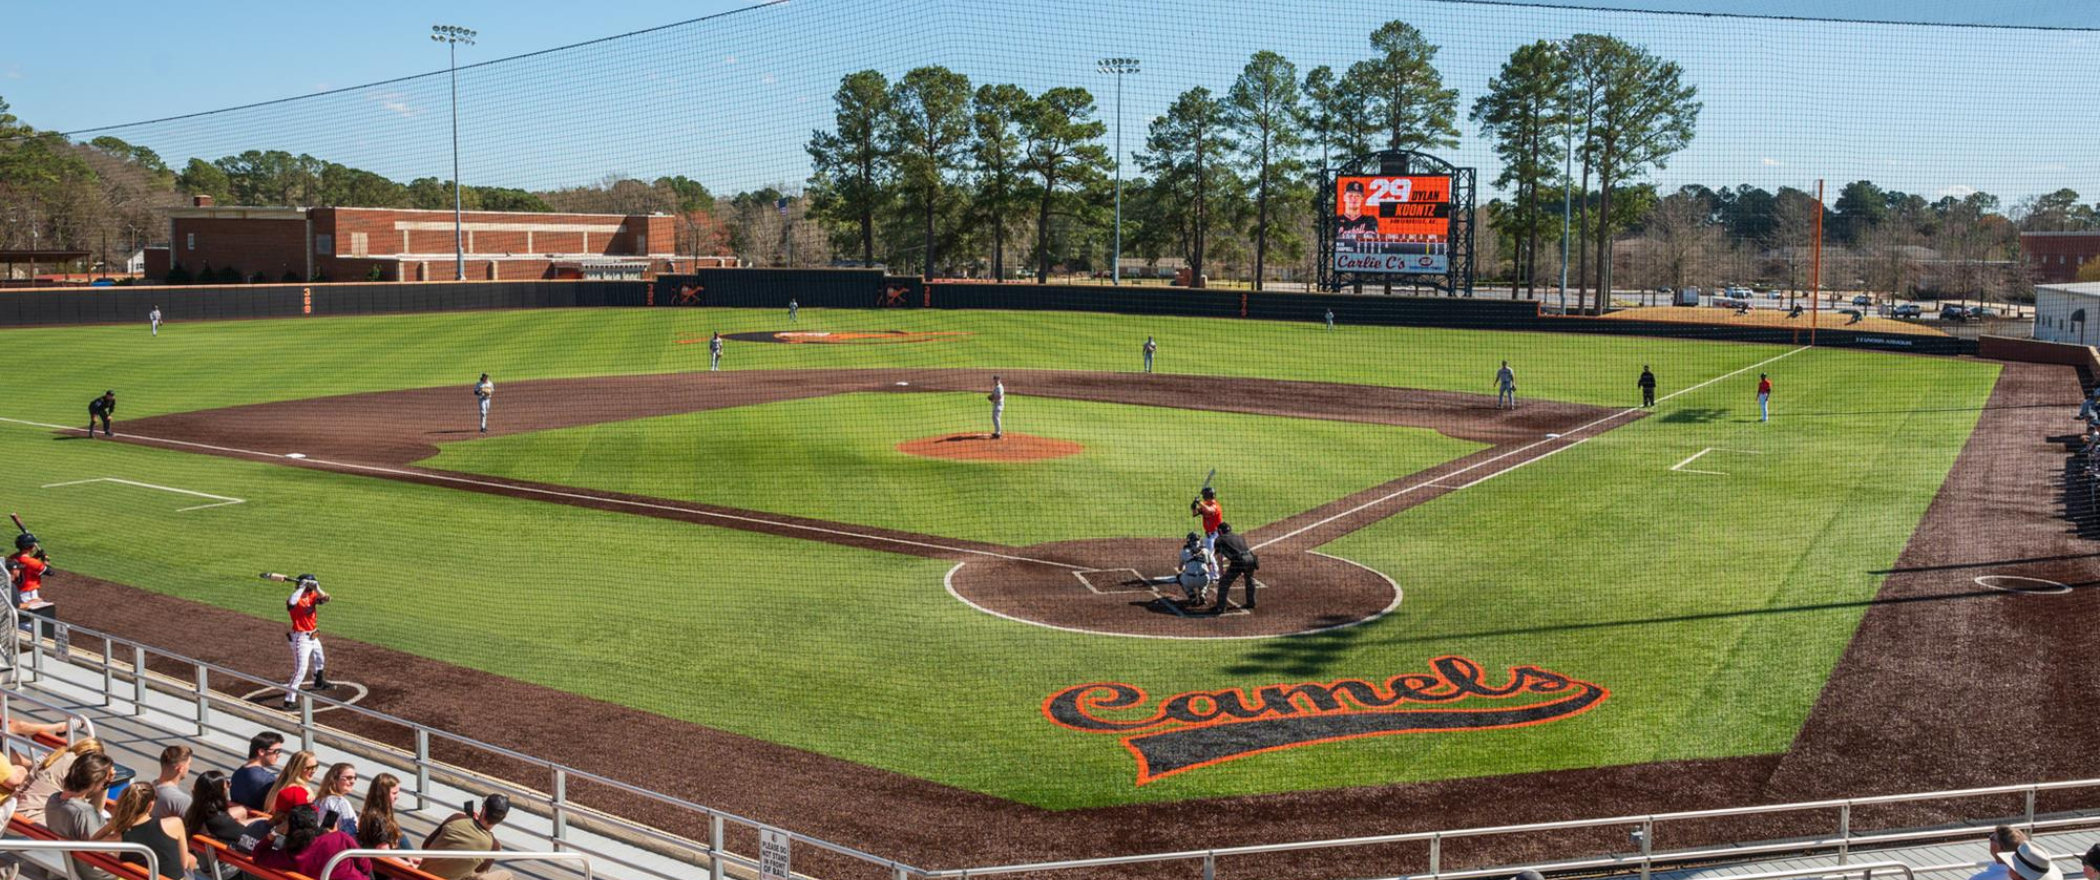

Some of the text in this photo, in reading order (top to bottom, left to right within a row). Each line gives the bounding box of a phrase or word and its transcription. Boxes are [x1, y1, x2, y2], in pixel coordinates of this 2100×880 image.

[1365, 178, 1412, 206] 29
[1412, 191, 1440, 201] DYLAN
[1395, 203, 1437, 217] KOONTZ
[1337, 255, 1382, 269] Carlie
[1385, 256, 1405, 270] C's
[1041, 655, 1600, 735] Camels
[762, 841, 787, 854] PLEASE DO
[773, 852, 787, 863] STAND
[772, 867, 786, 878] RAIL
